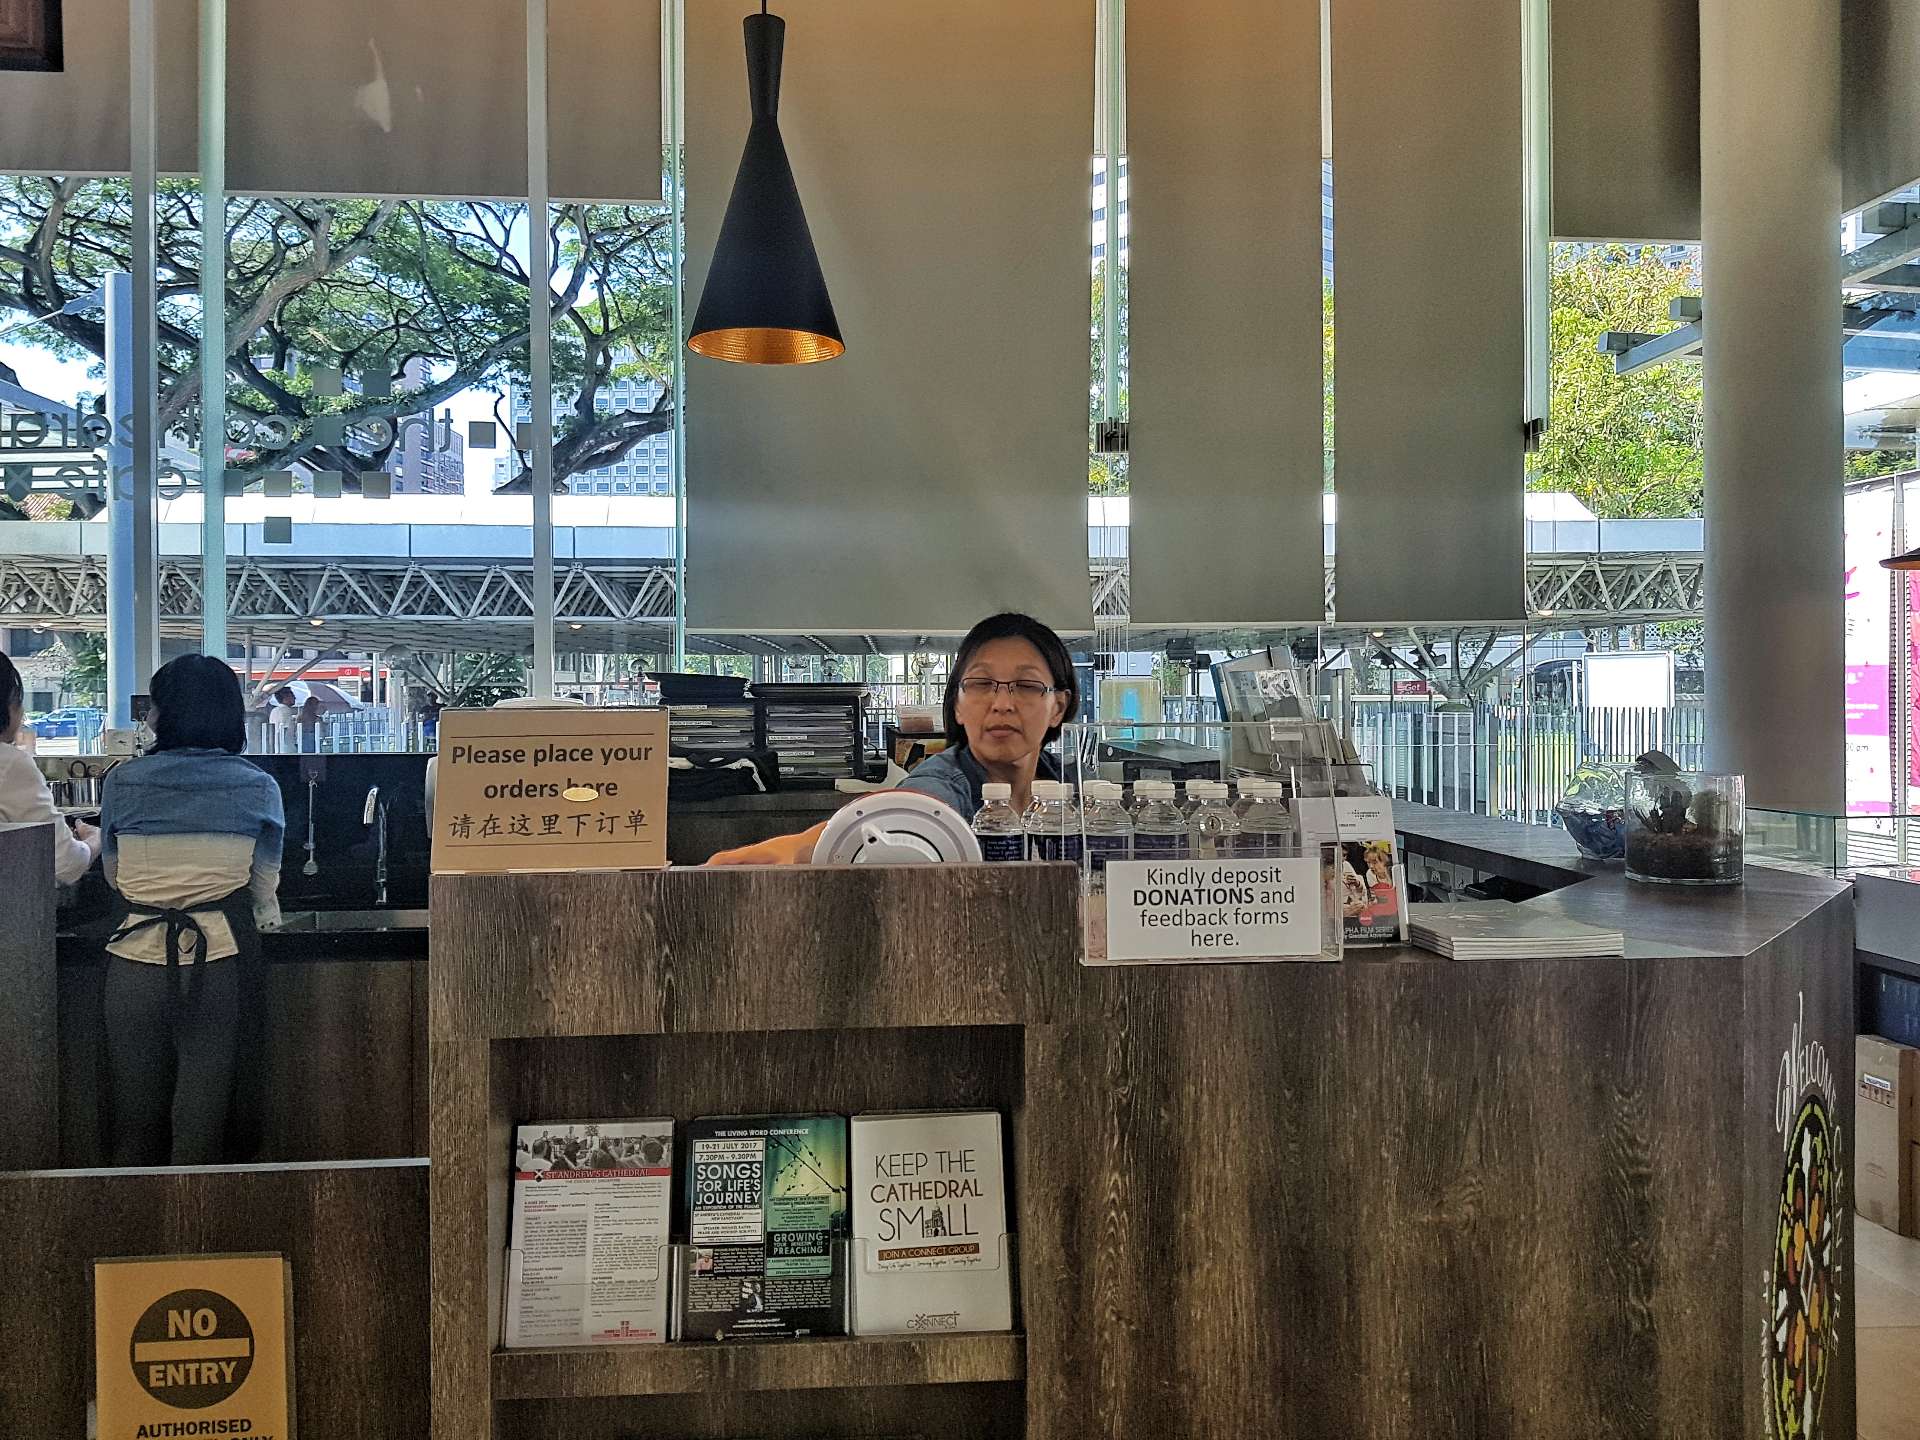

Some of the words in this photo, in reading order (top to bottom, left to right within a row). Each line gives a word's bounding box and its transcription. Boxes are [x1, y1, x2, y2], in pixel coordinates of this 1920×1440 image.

[452, 745, 526, 764] Please
[533, 744, 593, 767] place
[601, 746, 653, 766] your
[484, 779, 558, 799] orders
[449, 810, 648, 839] 请在这里下订单
[1147, 866, 1205, 888] Kindly
[1211, 866, 1282, 887] deposit
[1134, 887, 1254, 906] DONATIONS
[1260, 886, 1295, 905] and
[1140, 908, 1227, 928] feedback
[1233, 907, 1289, 926] forms
[1191, 929, 1240, 948] here.
[769, 1128, 809, 1136] CONFERENCE
[602, 1169, 649, 1178] CATHEDRAL
[697, 1163, 761, 1180] SONGS
[875, 1152, 928, 1178] KEEP
[935, 1150, 976, 1174] THE
[696, 1180, 722, 1192] FOR
[727, 1179, 761, 1192] LIFE'S
[871, 1178, 984, 1203] CATHEDRAL
[695, 1191, 761, 1205] JOURNEY
[773, 1232, 824, 1243] GROWING
[773, 1246, 823, 1255] PREACHING
[883, 1250, 900, 1260] JOIN
[901, 1250, 906, 1258] A
[907, 1247, 947, 1257] CONNECT
[948, 1244, 975, 1254] GROUP
[167, 1308, 218, 1338] NO
[149, 1361, 238, 1388] ENTRY
[136, 1418, 252, 1440] AUTHORISED
